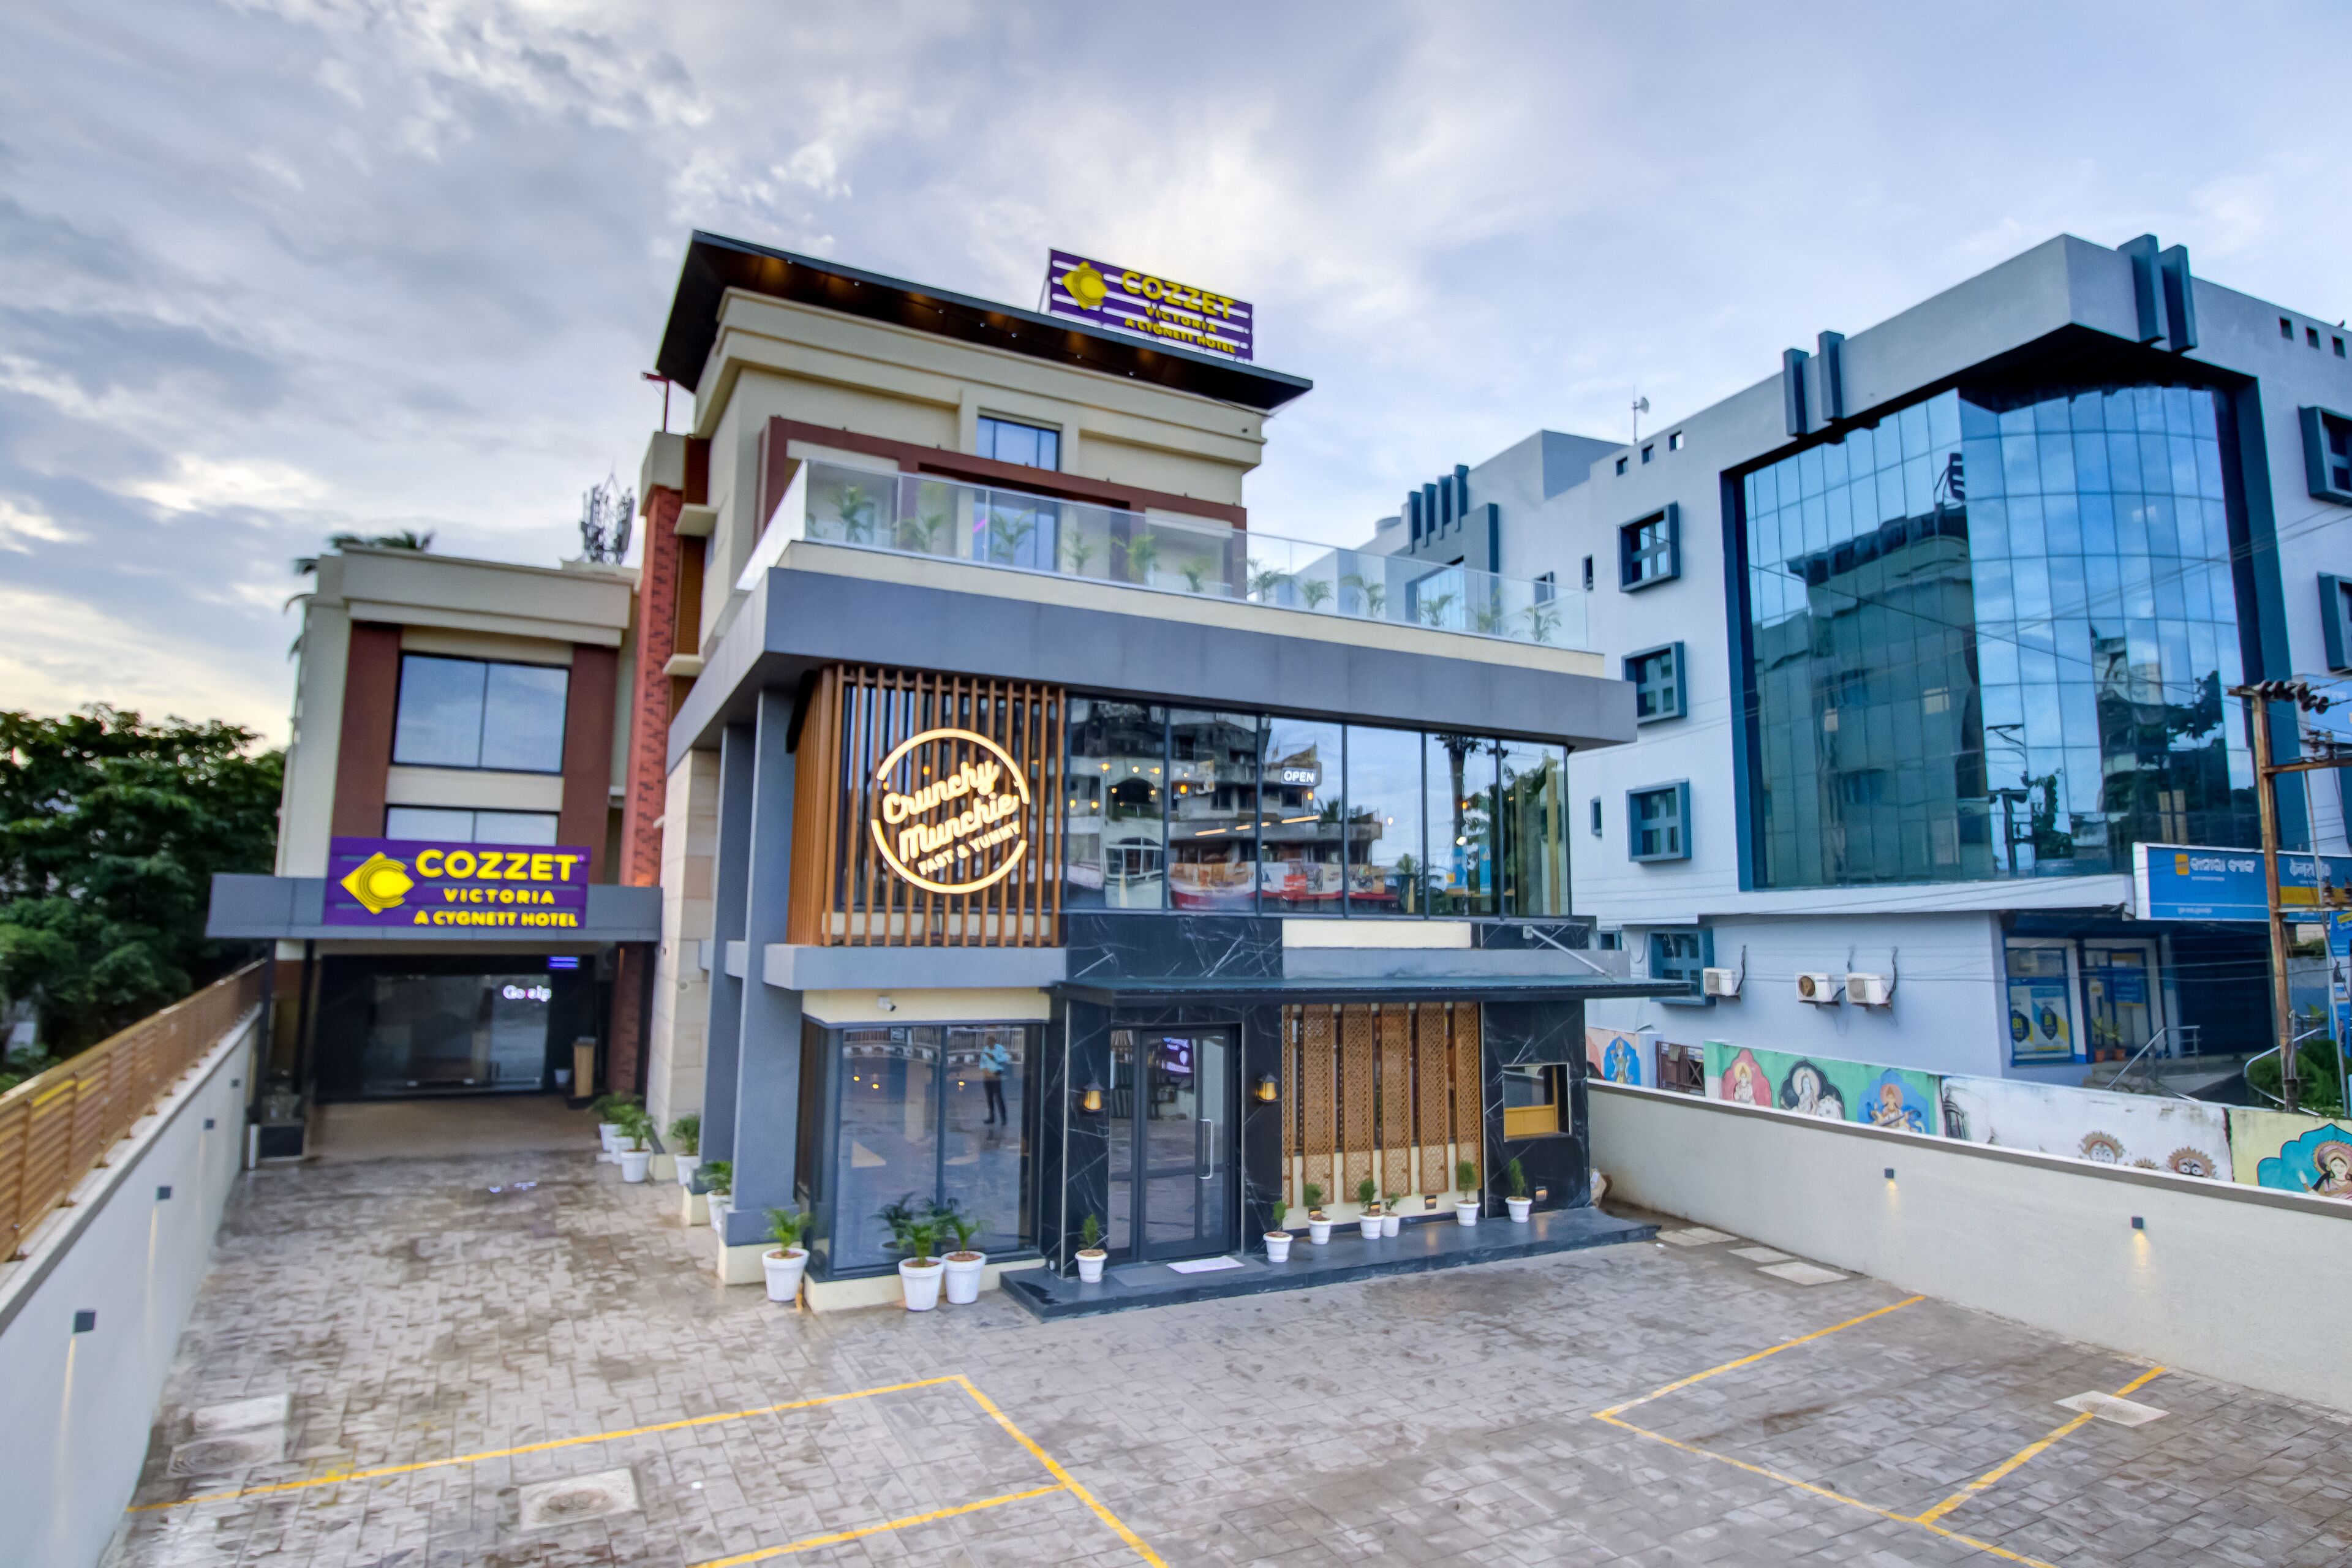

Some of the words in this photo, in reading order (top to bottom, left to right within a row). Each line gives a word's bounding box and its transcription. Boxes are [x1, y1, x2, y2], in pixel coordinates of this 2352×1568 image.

[1122, 271, 1235, 319] COZZET
[1125, 318, 1134, 328] A
[1137, 320, 1194, 342] CYGNETT
[1196, 334, 1235, 353] HOTEL
[1144, 306, 1218, 333] VICTORIA
[883, 760, 1000, 824] Crunchy
[1284, 770, 1314, 783] OPEN
[918, 849, 954, 875] FAST
[957, 845, 970, 858] &
[968, 820, 1020, 852] YUMMY
[415, 849, 578, 881] COZZET
[443, 888, 555, 905] VICTORIA
[413, 910, 429, 925] A
[432, 911, 518, 926] CYGNETT
[521, 912, 578, 927] HOTEL
